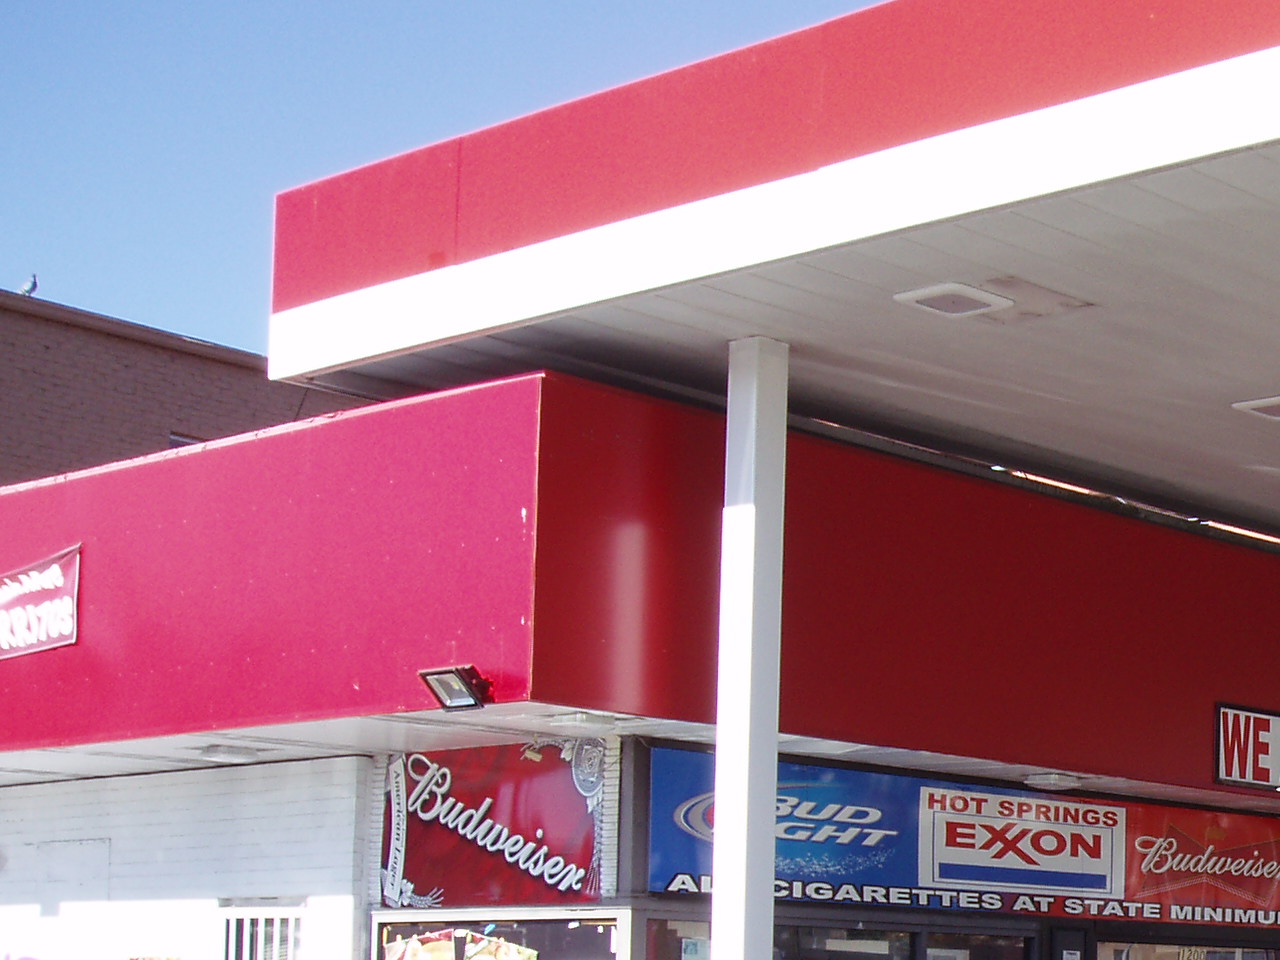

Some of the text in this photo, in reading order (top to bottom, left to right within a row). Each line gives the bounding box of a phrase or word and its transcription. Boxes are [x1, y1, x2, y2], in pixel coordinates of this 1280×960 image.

[1222, 711, 1271, 783] WE
[408, 753, 586, 892] Budweiser
[776, 795, 882, 825] BUD
[928, 792, 1119, 828] HOT SPRINGS
[774, 821, 898, 847] GHT
[945, 820, 1102, 866] EXXON
[774, 880, 1003, 909] CIGARETTES
[1012, 895, 1055, 912] AT
[1064, 898, 1161, 919] STATE
